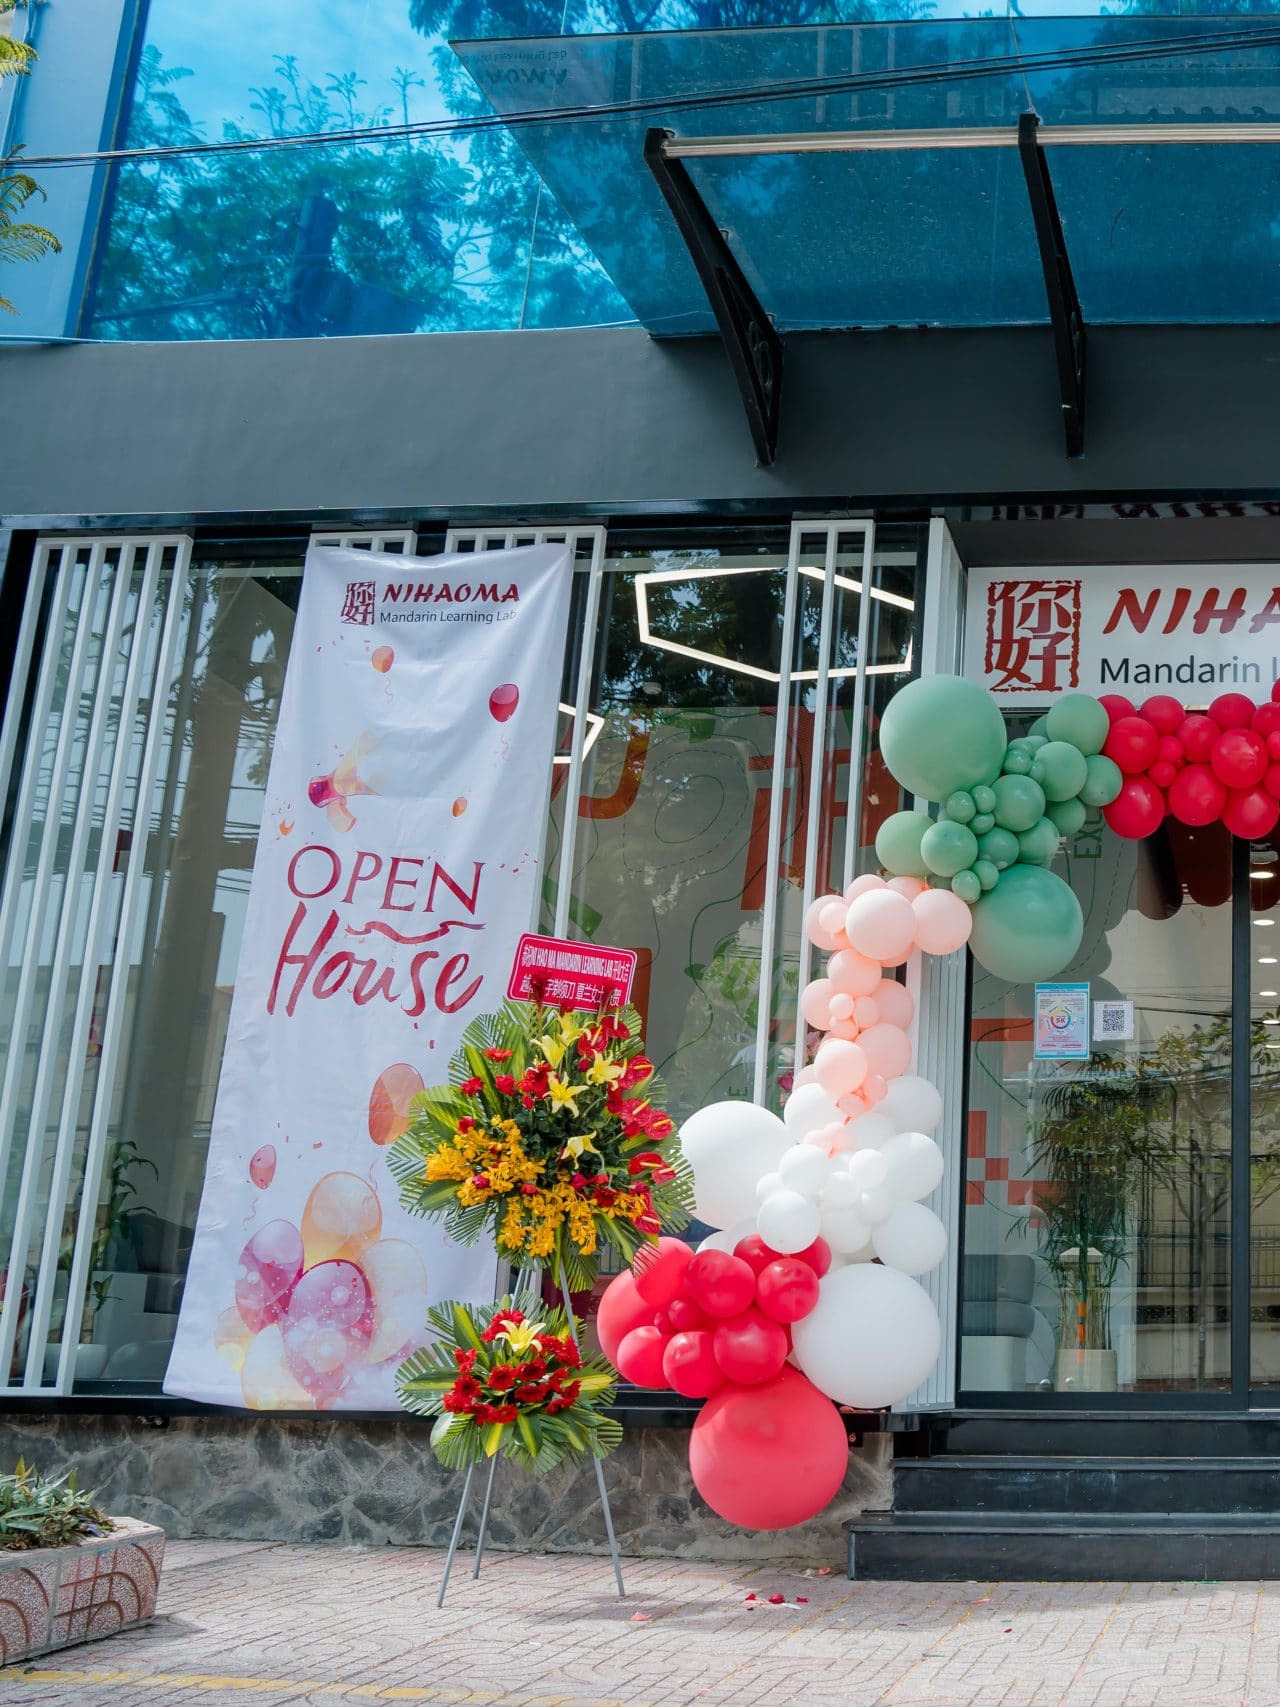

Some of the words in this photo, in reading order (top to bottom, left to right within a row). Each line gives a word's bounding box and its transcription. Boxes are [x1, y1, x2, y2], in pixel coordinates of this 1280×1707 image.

[340, 581, 376, 626] 你好
[382, 583, 520, 603] NIHAOMA
[380, 611, 437, 624] Mandarin
[440, 610, 493, 624] Learning
[496, 610, 517, 622] Lab
[986, 581, 1080, 692] 你好
[1101, 655, 1260, 684] Mandarin
[287, 845, 487, 915] OPEN
[267, 900, 484, 1017] House
